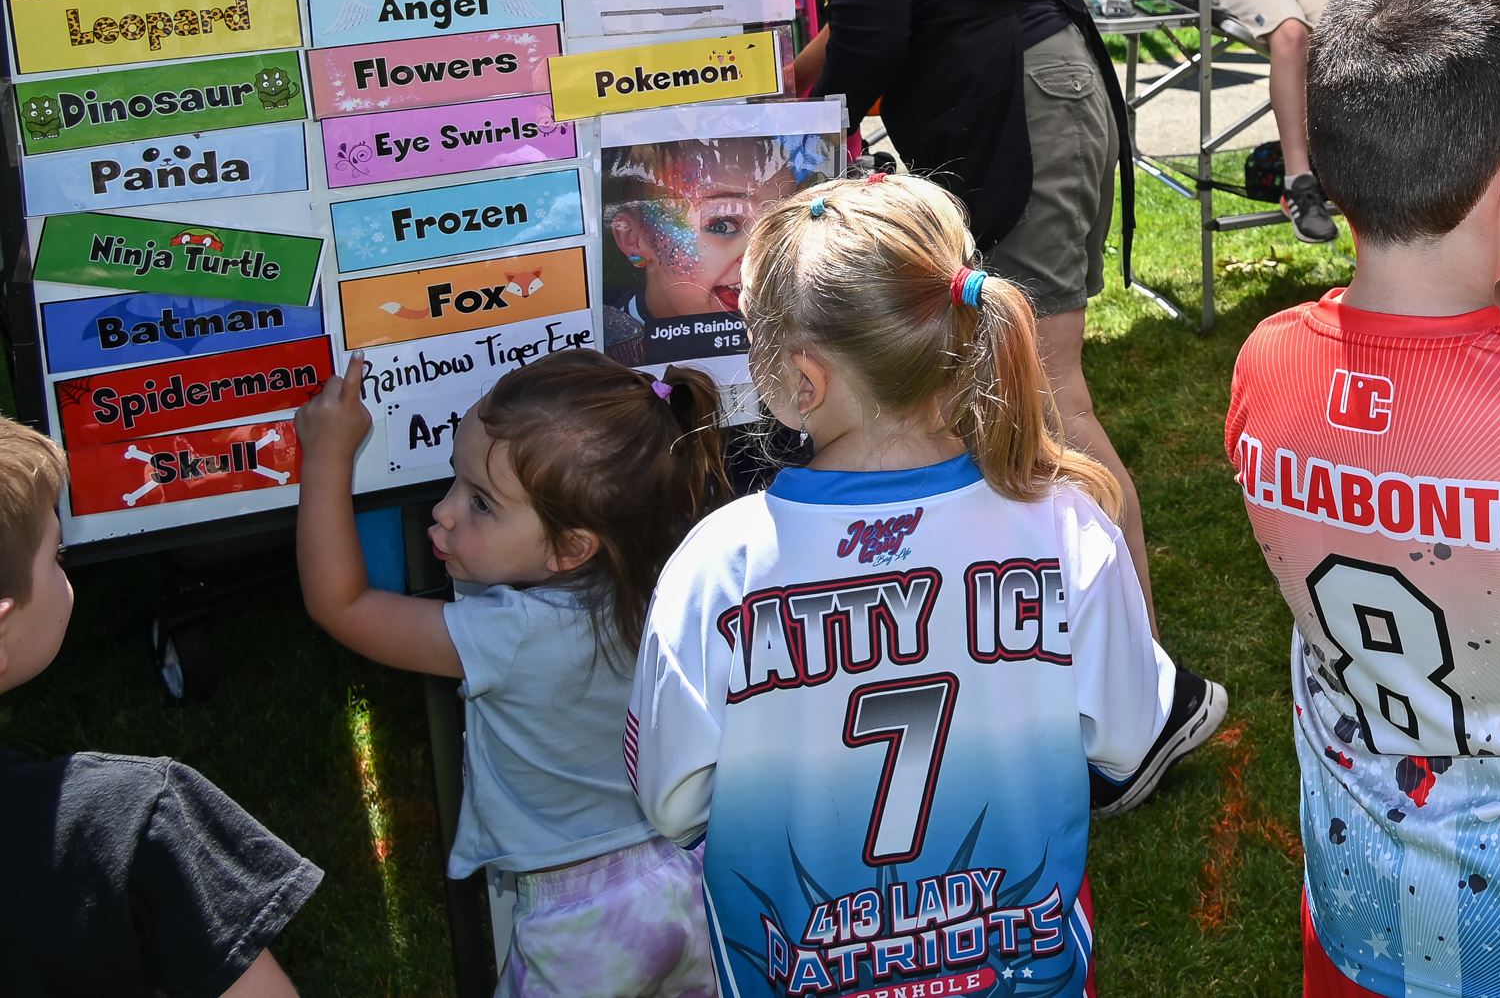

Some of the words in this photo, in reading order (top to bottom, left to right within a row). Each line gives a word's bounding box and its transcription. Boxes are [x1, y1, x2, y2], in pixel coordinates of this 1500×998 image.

[352, 48, 518, 89] Flowers
[594, 62, 740, 98] Pokemon
[60, 80, 254, 128] Dinosaur
[375, 131, 428, 161] Eye
[439, 116, 539, 150] Swirls
[90, 150, 251, 196] Panda
[391, 201, 529, 243] Frozen
[88, 233, 174, 270] Ninja
[183, 244, 282, 282] Turtle
[427, 283, 510, 320] Fox
[96, 305, 284, 351] Batman
[650, 323, 691, 341] Jojo's
[713, 334, 741, 349] $15
[92, 362, 318, 429] Spiderman
[359, 351, 474, 404] Rainbow
[150, 443, 259, 485] Skull
[836, 506, 924, 559] Jersey
[964, 558, 1073, 666] ICE
[1306, 553, 1470, 757] 8
[842, 672, 960, 868] 7
[803, 886, 885, 946] 413
[886, 867, 1006, 936] LADY
[760, 882, 1066, 996] PATRIOTS
